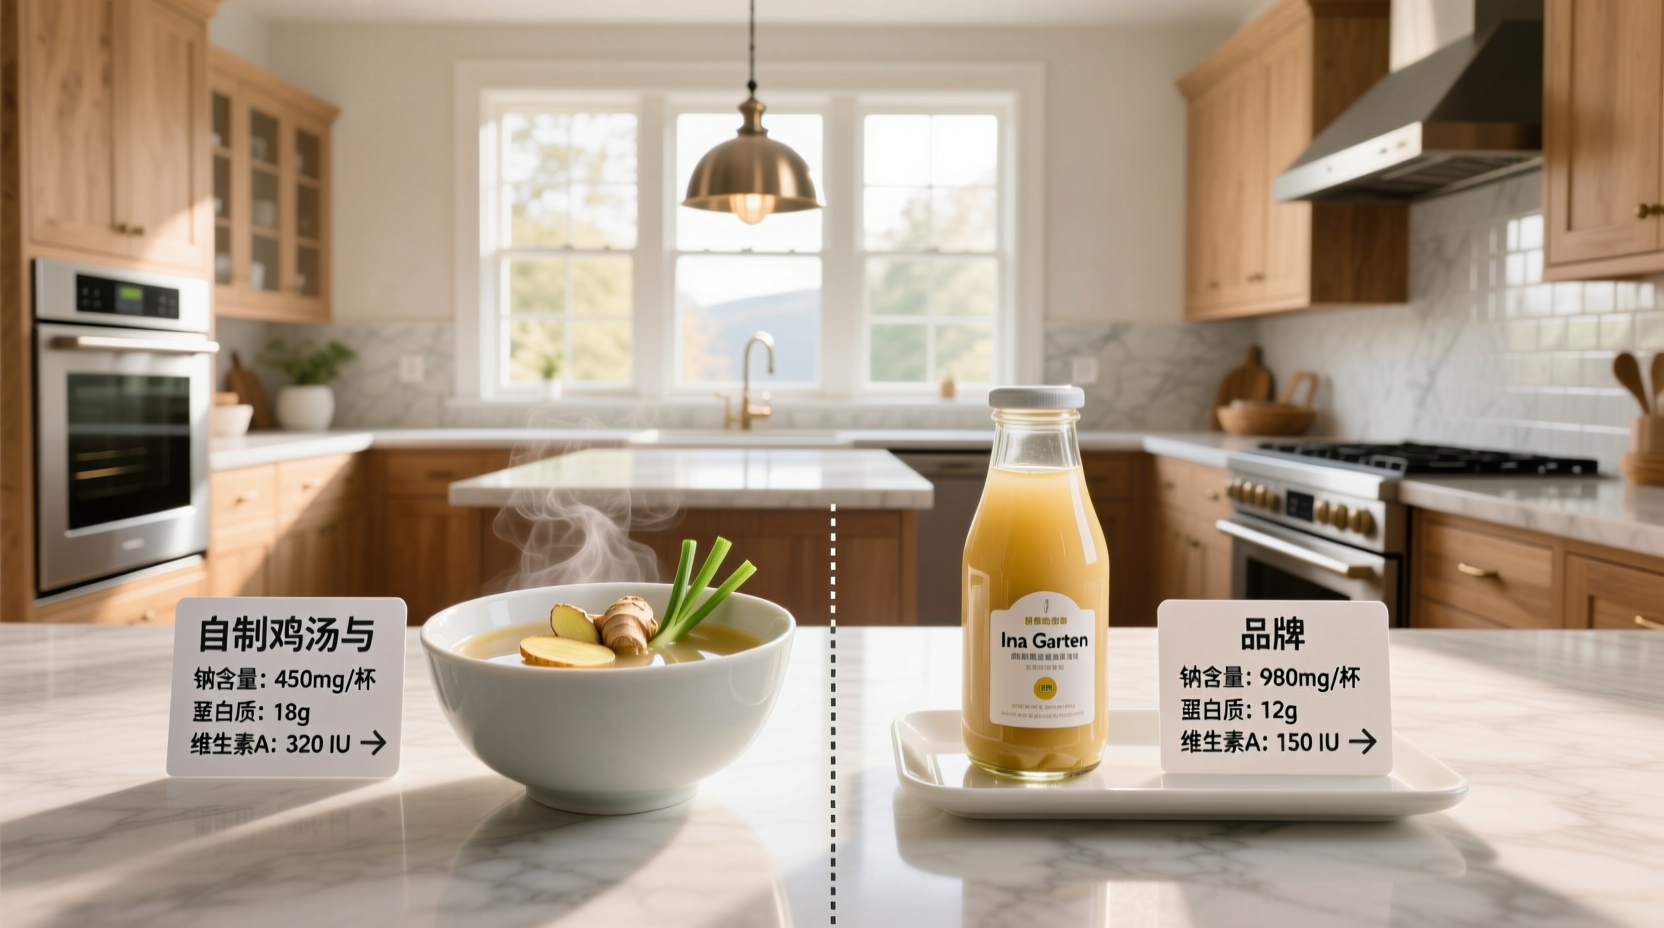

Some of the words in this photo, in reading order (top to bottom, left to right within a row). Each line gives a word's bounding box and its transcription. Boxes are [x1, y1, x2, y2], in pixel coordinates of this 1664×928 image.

[200, 615, 374, 652] 自制鸡汤与
[1002, 632, 1027, 648] Ina
[1032, 632, 1088, 649] Garten
[1242, 616, 1305, 651] 品牌
[274, 667, 376, 694] 450mg/杯
[1260, 666, 1360, 692] 980mg/杯
[275, 703, 310, 726] 18g
[1261, 700, 1297, 725] 12g
[286, 734, 323, 753] 320
[330, 734, 350, 753] IU
[1277, 733, 1312, 751] 150
[1320, 733, 1339, 752] IU
